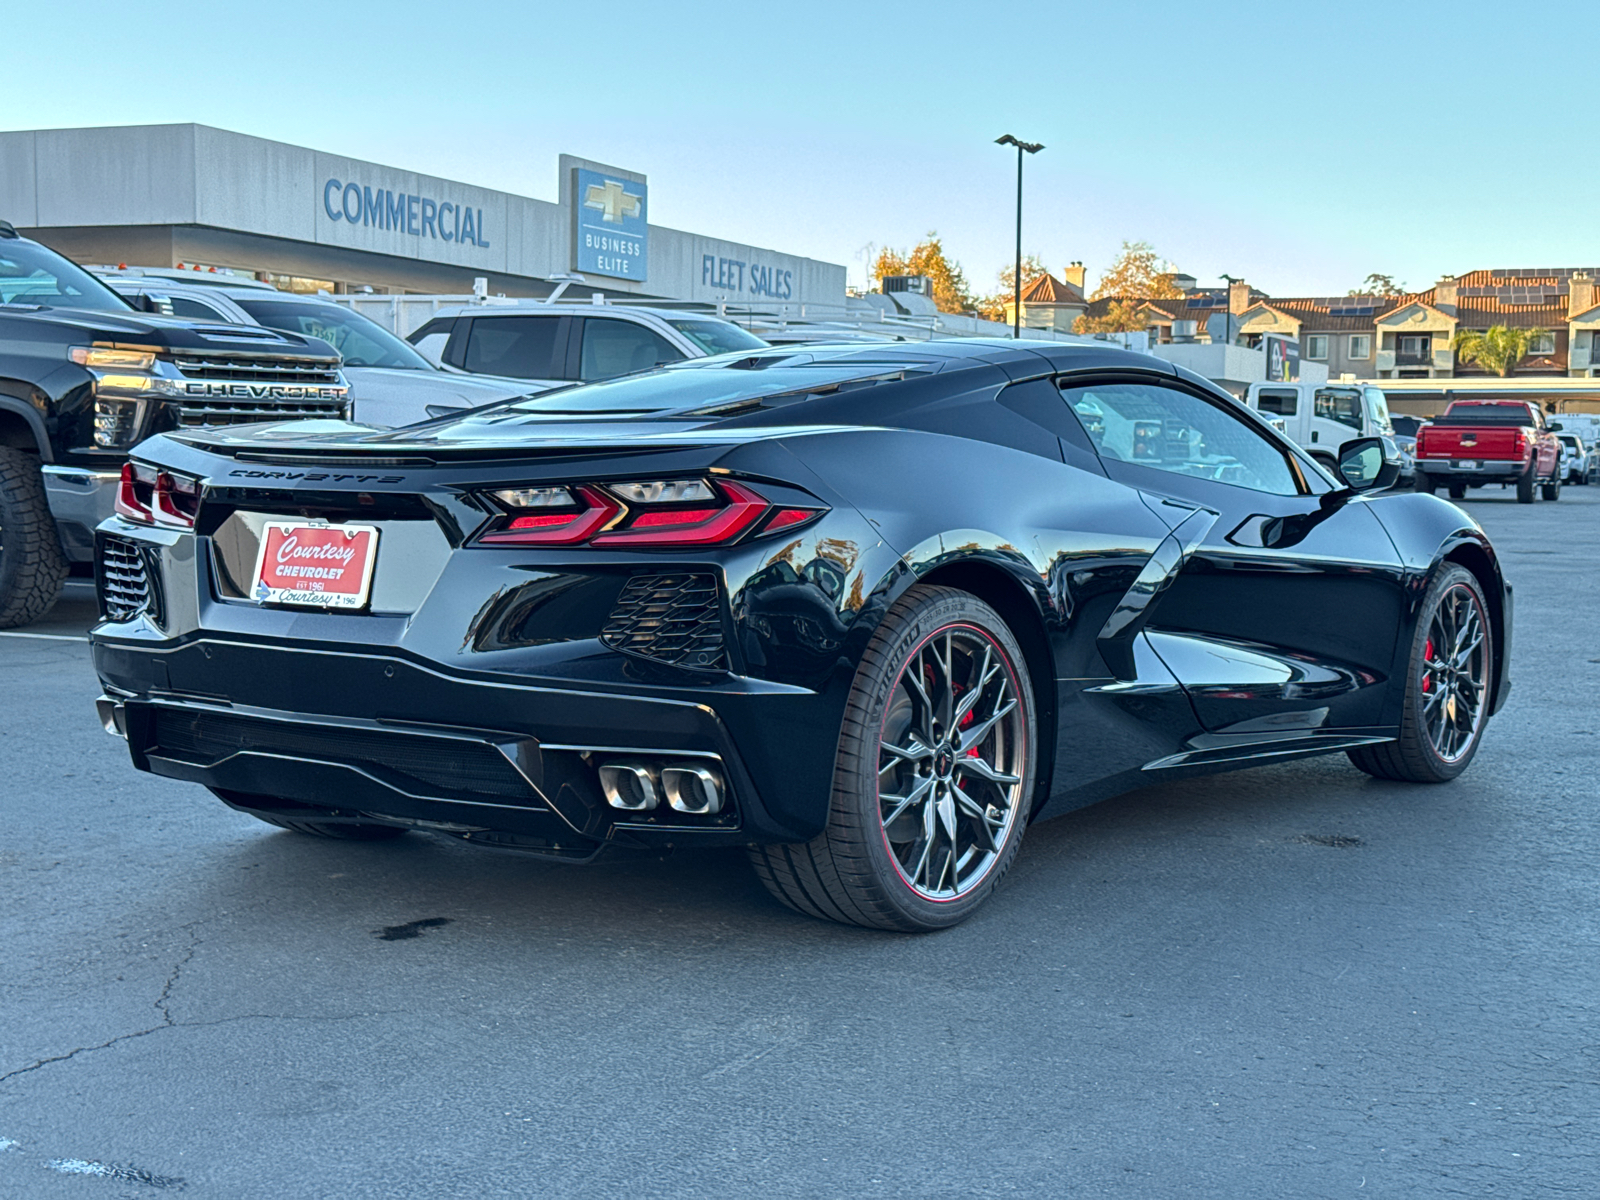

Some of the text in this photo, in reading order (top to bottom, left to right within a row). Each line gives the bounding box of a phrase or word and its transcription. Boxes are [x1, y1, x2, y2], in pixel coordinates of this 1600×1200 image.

[324, 178, 490, 248] COMMERCIAL
[585, 233, 640, 256] BUSINESS
[597, 256, 629, 273] ELITE
[702, 254, 792, 300] FLEET SALES
[184, 383, 344, 400] CHEVROLET
[228, 469, 406, 484] CORVETTE
[277, 535, 356, 567] Courtesy
[275, 565, 345, 580] CHEVROLET
[308, 581, 325, 592] 1961
[279, 588, 333, 606] Courtesy
[343, 597, 356, 605] 1961
[877, 627, 920, 699] MICHELIN
